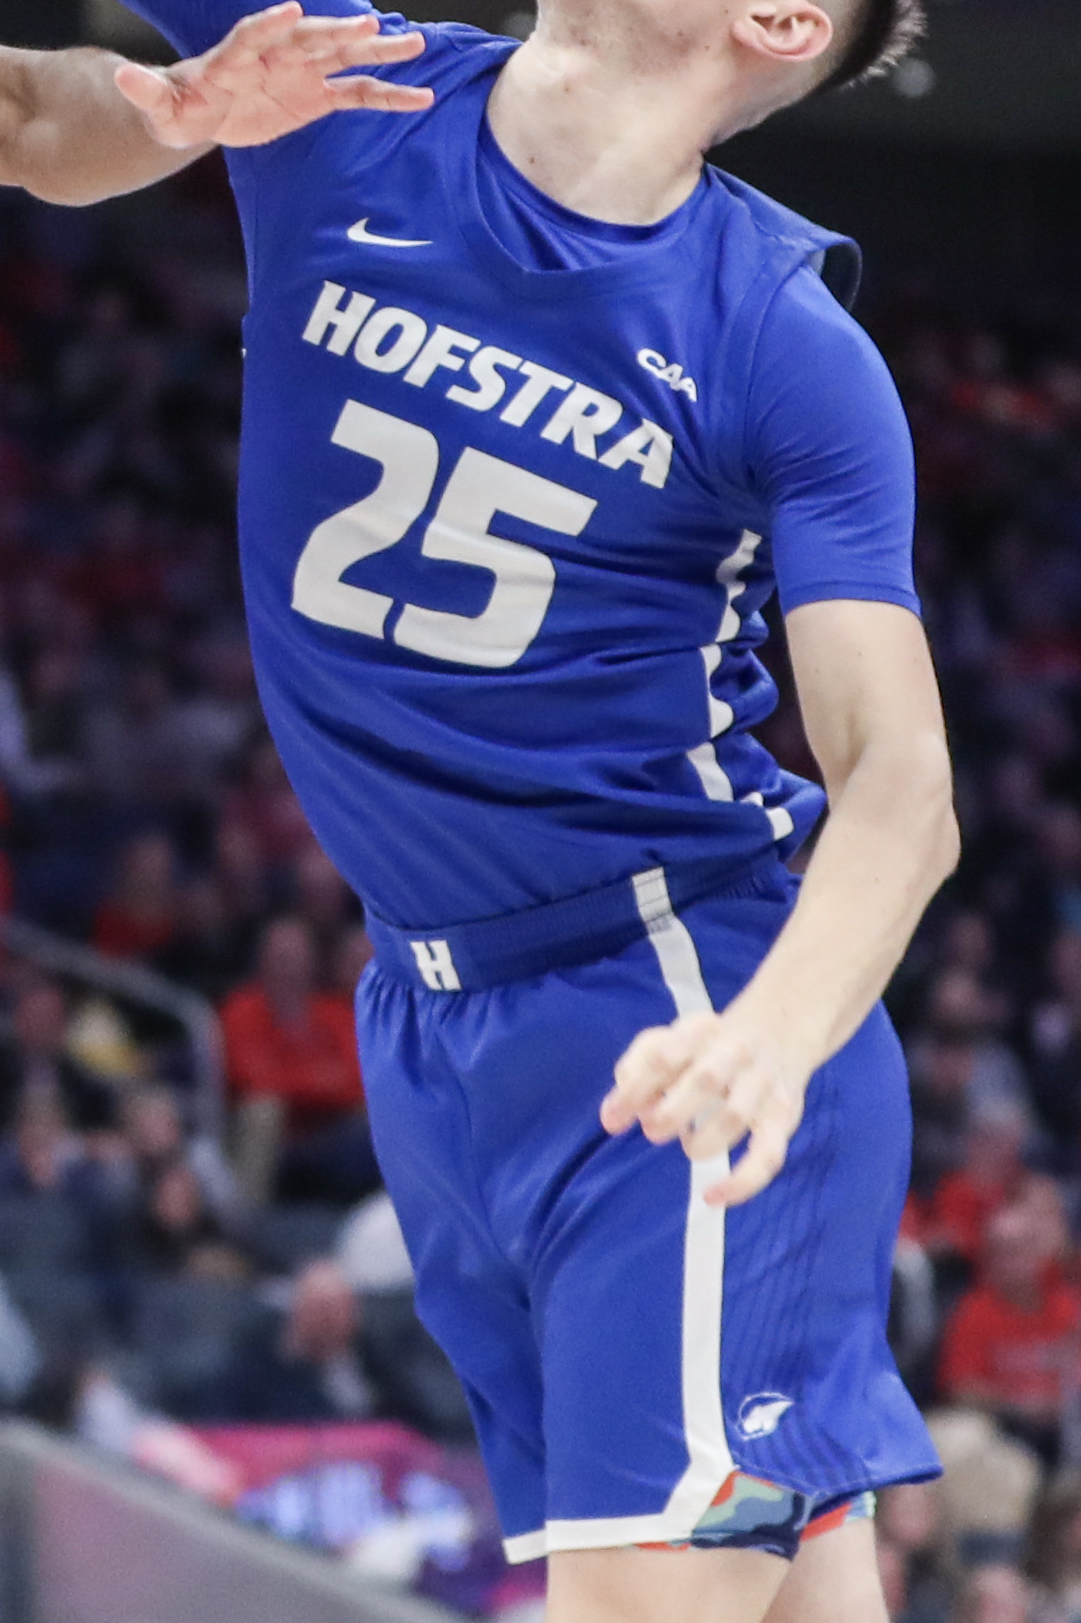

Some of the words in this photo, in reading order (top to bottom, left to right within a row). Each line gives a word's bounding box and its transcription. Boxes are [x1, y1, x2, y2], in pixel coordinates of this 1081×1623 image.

[301, 280, 674, 489] HOFSTRA
[637, 348, 697, 403] CAA
[290, 398, 599, 668] 25
[409, 939, 463, 992] H
